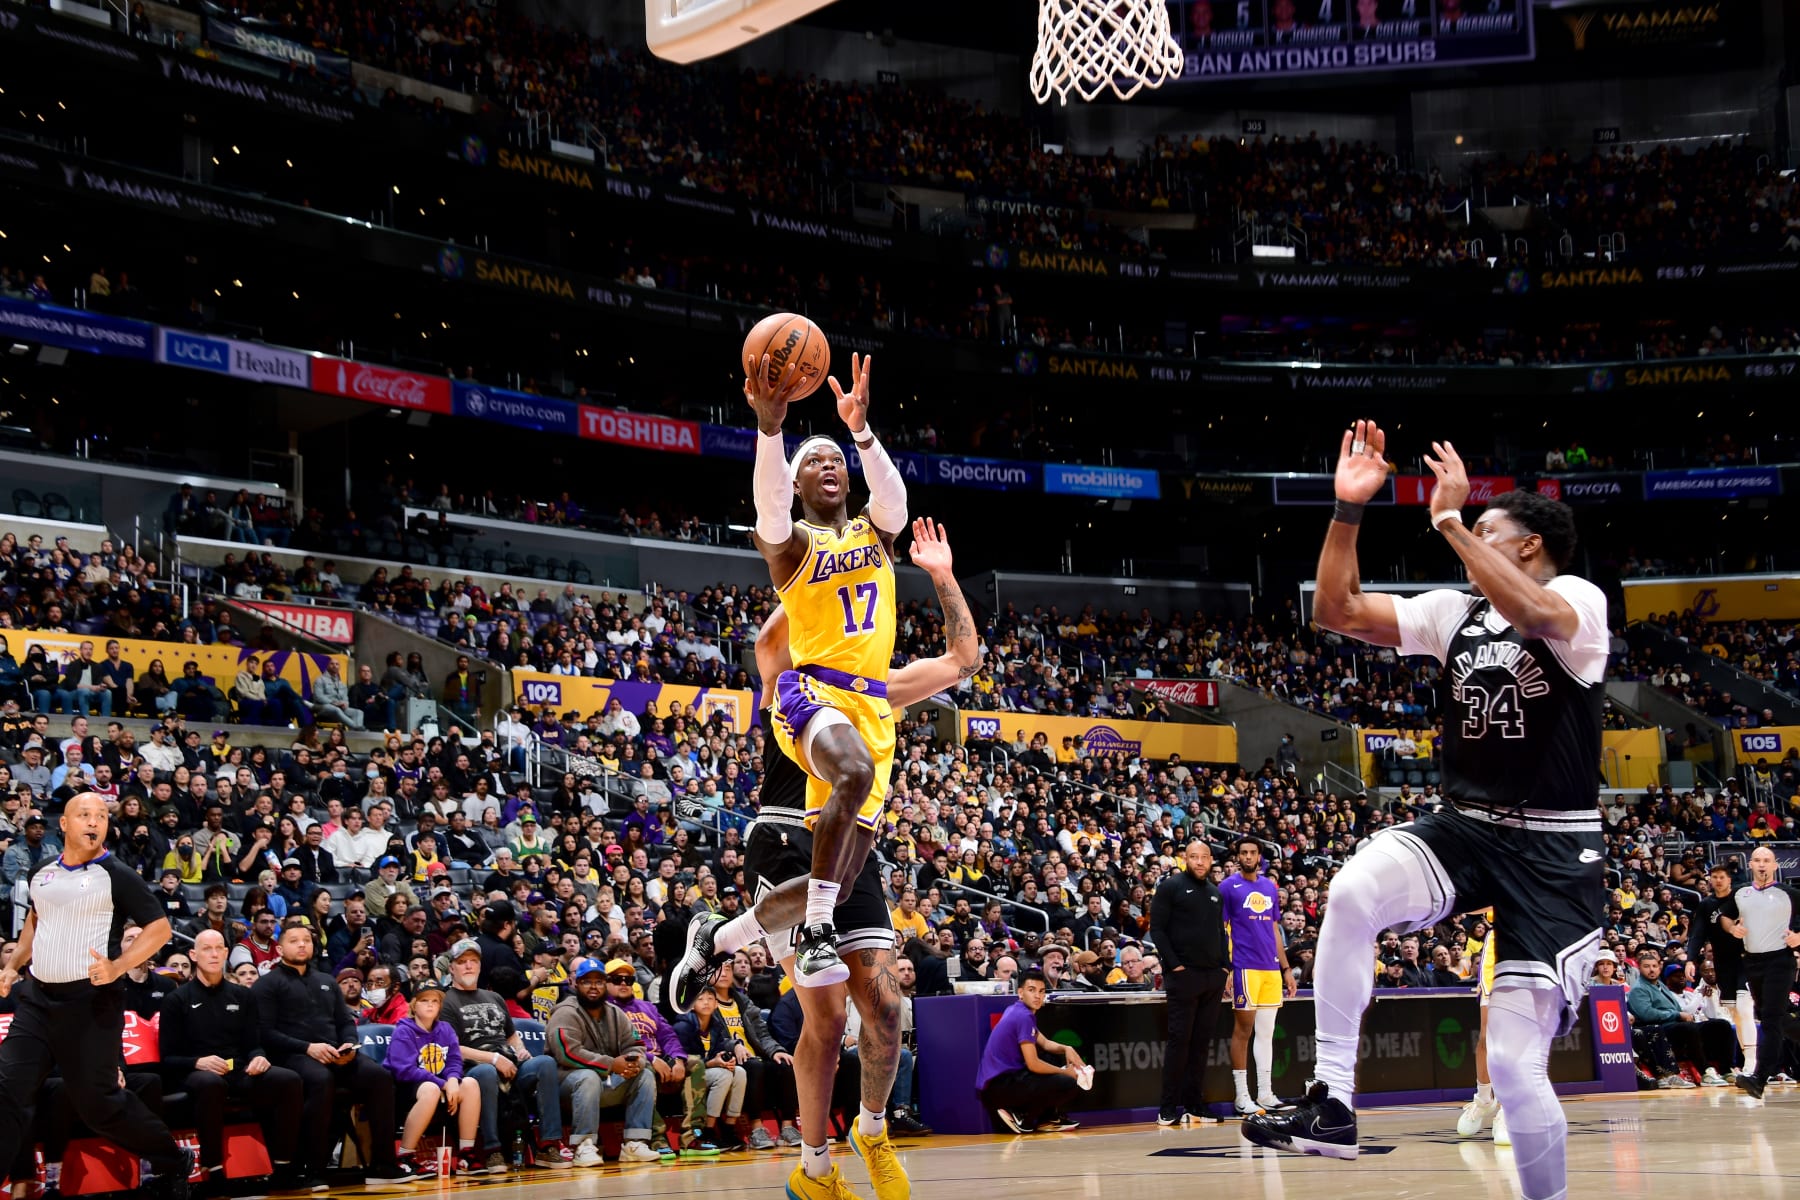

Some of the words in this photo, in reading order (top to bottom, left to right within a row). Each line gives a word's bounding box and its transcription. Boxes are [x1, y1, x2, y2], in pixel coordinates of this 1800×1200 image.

[234, 28, 317, 65] Spectrum
[1184, 53, 1233, 75] SAN
[1239, 45, 1348, 72] ANTONIO
[1354, 41, 1437, 64] SPURS
[496, 147, 594, 191] SANTANA
[636, 182, 652, 201] 17
[1018, 248, 1110, 277] SANTANA
[1148, 262, 1161, 279] 17
[1540, 266, 1645, 289] SANTANA
[1691, 264, 1706, 279] 17
[474, 257, 577, 301] SANTANA
[618, 293, 633, 309] 17
[76, 323, 147, 349] EXPRESS
[173, 339, 224, 365] UCLA
[235, 348, 304, 382] Health
[768, 328, 804, 388] Wilson
[1047, 354, 1140, 380] SANTANA
[1180, 368, 1192, 382] 17
[1624, 363, 1732, 386] SANTANA
[1780, 361, 1794, 376] 17
[489, 397, 566, 425] crypto.com
[584, 411, 695, 448] TOSHIBA
[937, 459, 1027, 485] Spectrum
[1060, 470, 1144, 489] mobilitie
[1653, 478, 1715, 491] AMERICAN
[1716, 475, 1773, 489] EXPRESS
[1563, 481, 1622, 496] TOYOTA
[807, 543, 883, 585] LAKERS
[838, 581, 879, 638] 17
[1452, 650, 1474, 702] SAN
[1473, 640, 1551, 699] ANTONIO
[526, 684, 558, 703] 102
[1461, 684, 1526, 739] 34
[970, 719, 997, 737] 103
[1744, 736, 1777, 750] 105
[517, 1031, 546, 1041] DELT
[1374, 1032, 1422, 1058] MEAT
[1094, 1040, 1168, 1072] BEYON
[1600, 1052, 1632, 1065] TOYOTA
